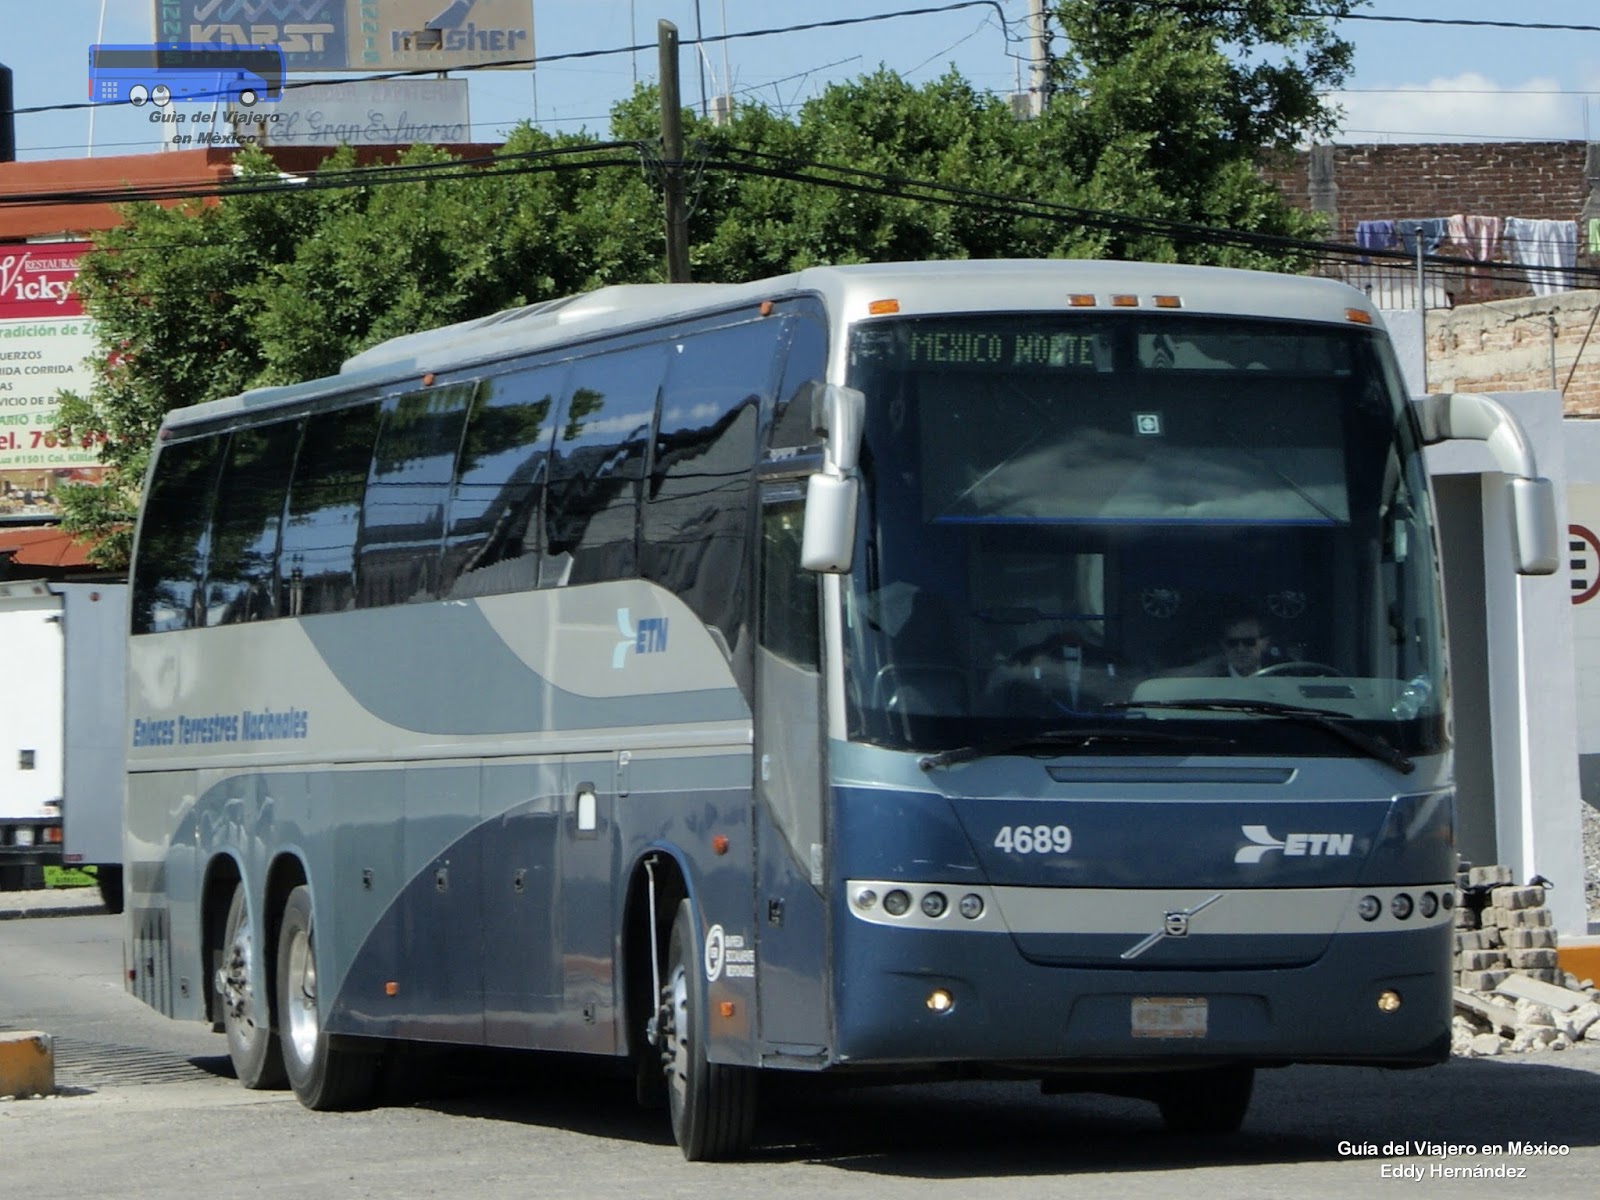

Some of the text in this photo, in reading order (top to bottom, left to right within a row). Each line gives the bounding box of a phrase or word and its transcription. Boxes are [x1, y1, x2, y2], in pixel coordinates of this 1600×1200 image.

[307, 110, 361, 142] Gran
[61, 324, 79, 336] de
[911, 332, 1093, 363] MEXICO NORTE
[24, 365, 74, 375] CORRIDA
[30, 396, 44, 405] DE
[636, 617, 669, 654] ETN
[179, 714, 238, 745] Terrestres
[242, 706, 308, 741] Nacionales
[994, 824, 1072, 854] 4689
[1283, 833, 1354, 856] ETN
